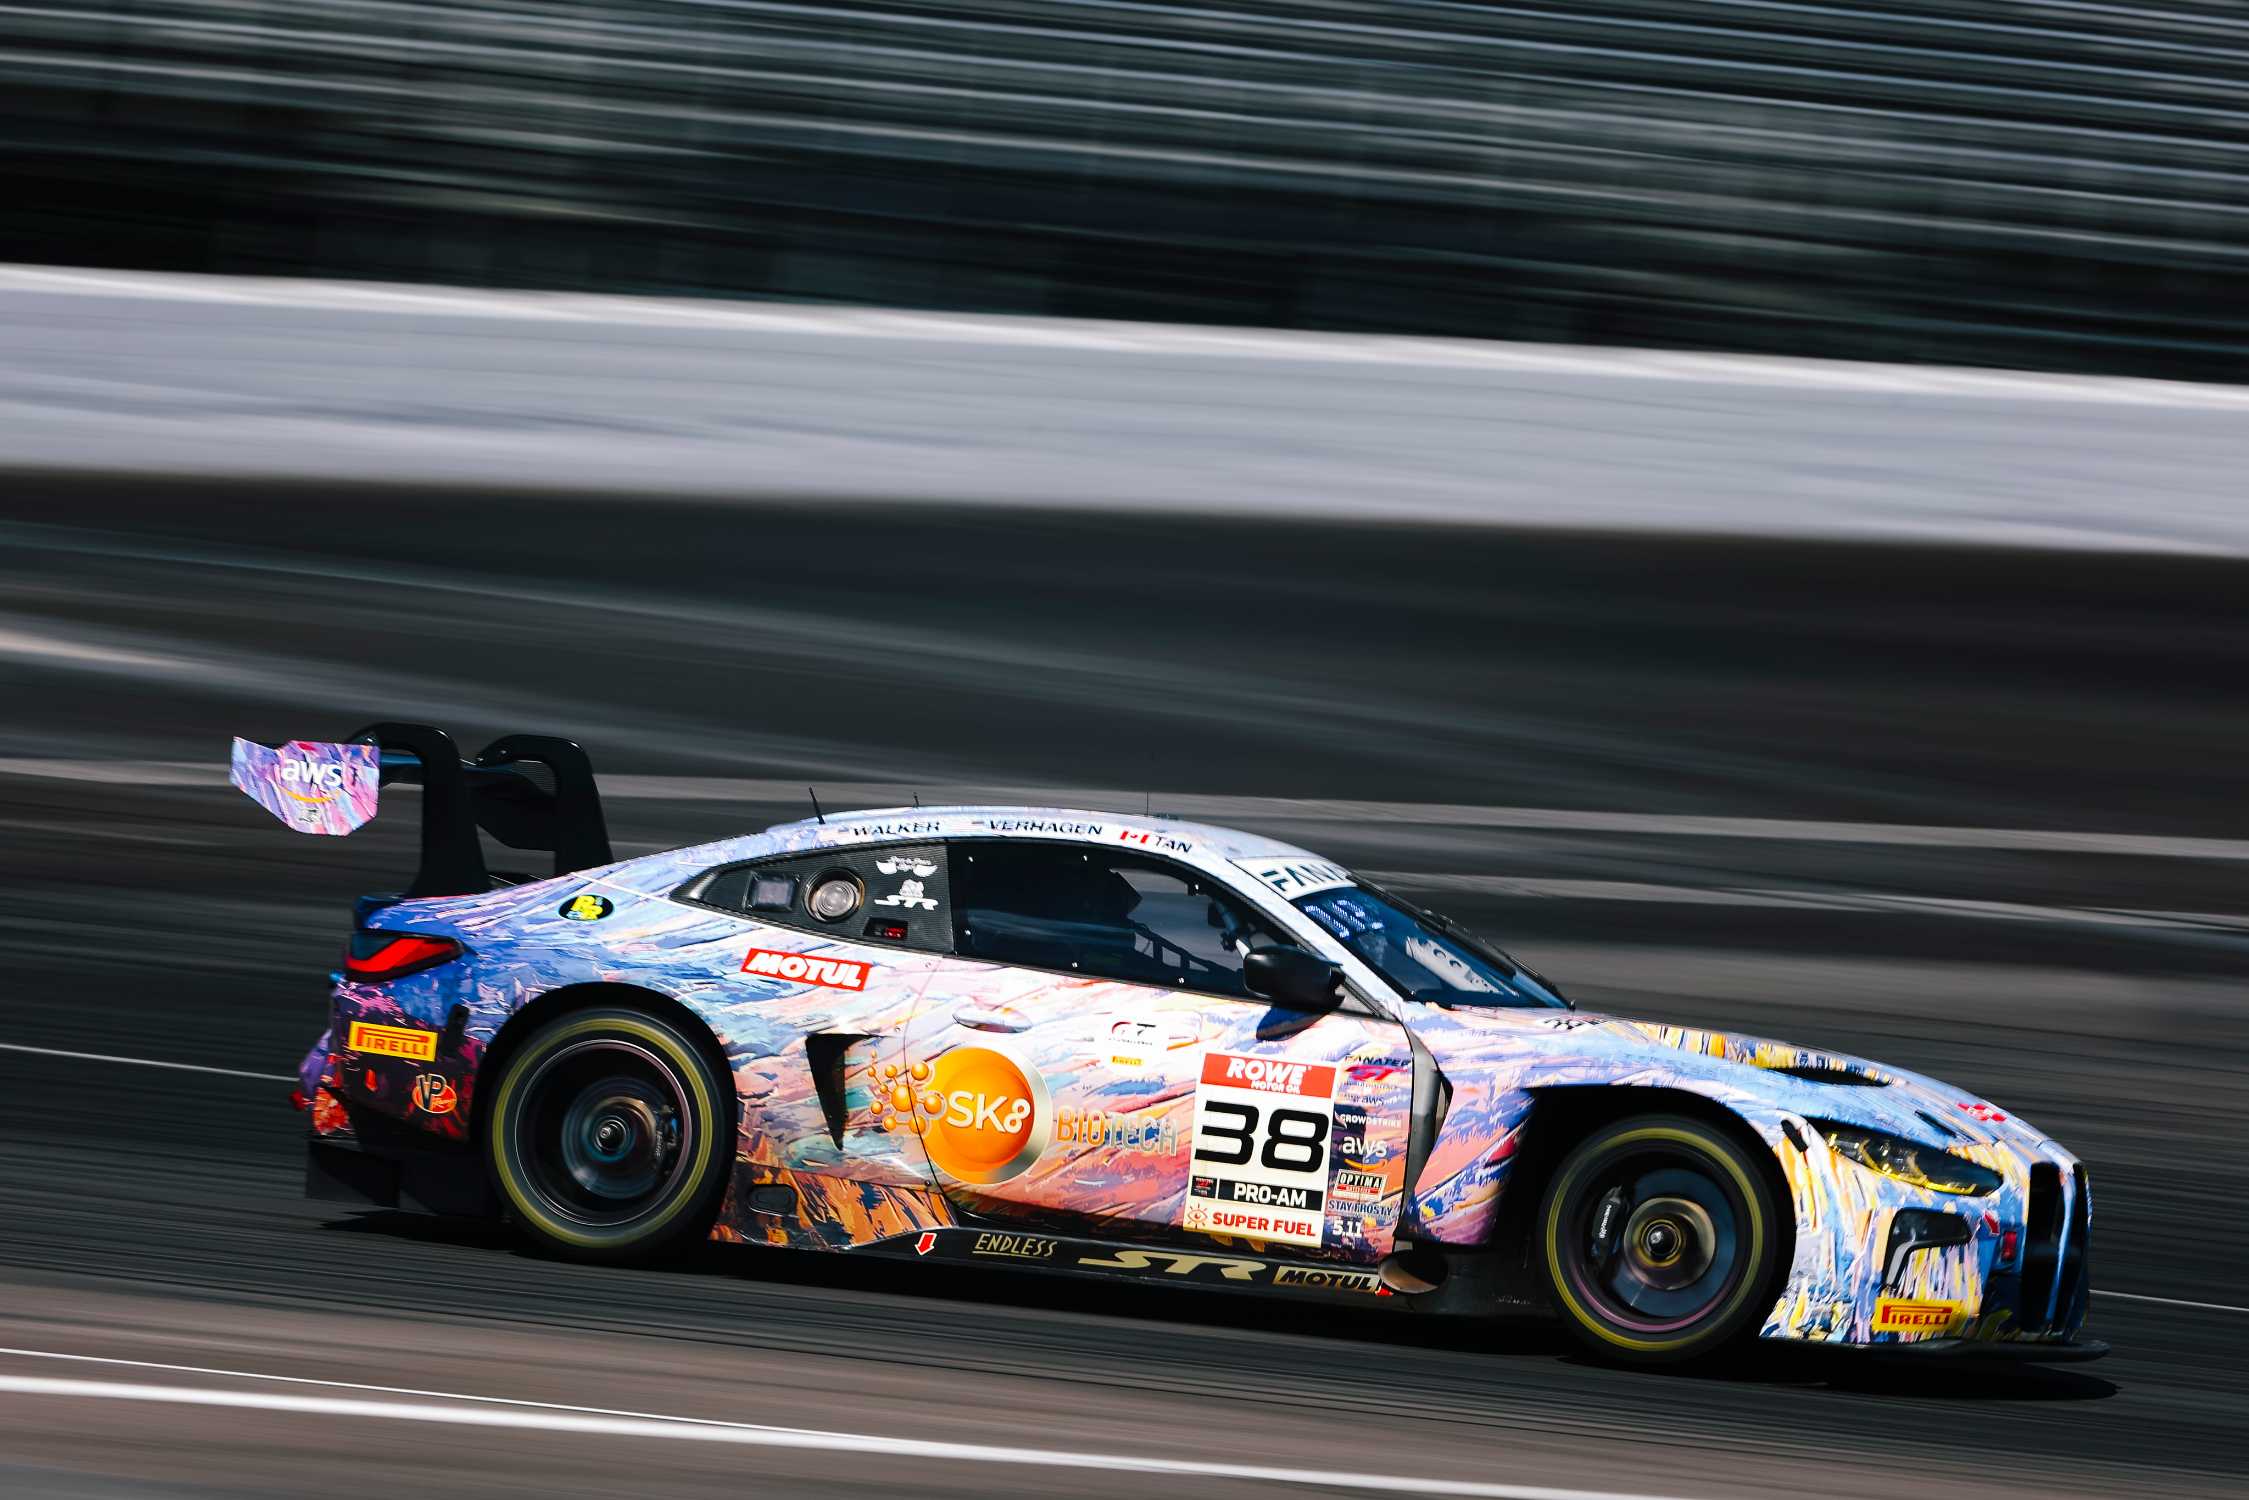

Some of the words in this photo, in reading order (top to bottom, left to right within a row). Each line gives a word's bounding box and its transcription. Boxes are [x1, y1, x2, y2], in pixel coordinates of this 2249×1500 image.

[281, 758, 342, 787] aws
[853, 821, 940, 836] WALKER
[989, 820, 1103, 835] VERHAGEN
[1155, 835, 1193, 853] TAN
[745, 952, 861, 988] MOTUL
[356, 1027, 429, 1056] PIRELLI
[1226, 1057, 1306, 1085] ROWE
[416, 1073, 447, 1110] VP
[1251, 1080, 1284, 1093] MOTOR
[945, 1090, 1031, 1134] SK8
[1056, 1105, 1177, 1156] BIOTECH
[1194, 1100, 1330, 1173] 38
[1342, 1136, 1387, 1158] aws
[1340, 1173, 1381, 1188] OPTIMA
[1233, 1183, 1307, 1208] PRO-AM
[1329, 1200, 1353, 1212] STAY
[1354, 1203, 1392, 1216] FROSTY
[1213, 1212, 1269, 1231] SUPER
[1273, 1219, 1316, 1236] FUEL
[975, 1233, 1057, 1257] ENDLESS
[1281, 1269, 1372, 1290] MOTUL
[1881, 1305, 1953, 1324] PIRELLI
